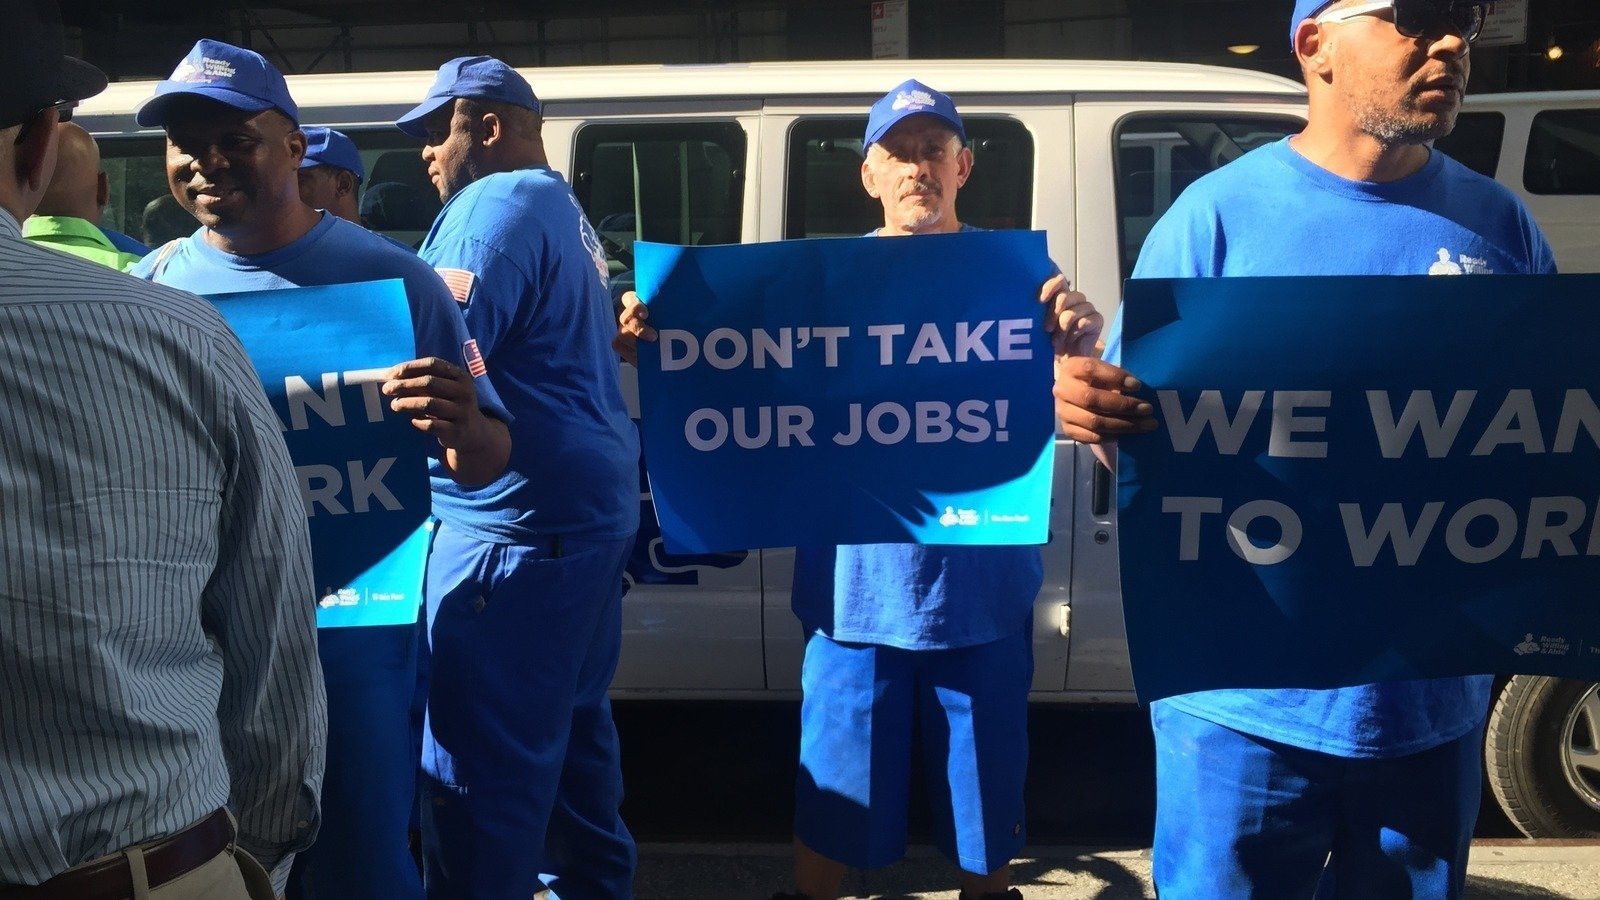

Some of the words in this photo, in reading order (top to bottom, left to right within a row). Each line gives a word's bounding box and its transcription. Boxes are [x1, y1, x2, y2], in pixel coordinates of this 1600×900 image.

[203, 57, 231, 67] Ready
[205, 64, 236, 75] Willing
[1459, 254, 1488, 267] Ready
[660, 327, 850, 371] DON'T
[868, 319, 1034, 365] TAKE
[275, 367, 392, 432] NT
[685, 406, 815, 451] OUR
[833, 400, 1009, 445] JOBS!
[1156, 390, 1332, 458] WE
[1162, 497, 1303, 566] TO
[1339, 496, 1600, 567] WOR
[1540, 635, 1566, 643] Ready
[1542, 642, 1570, 651] Willing
